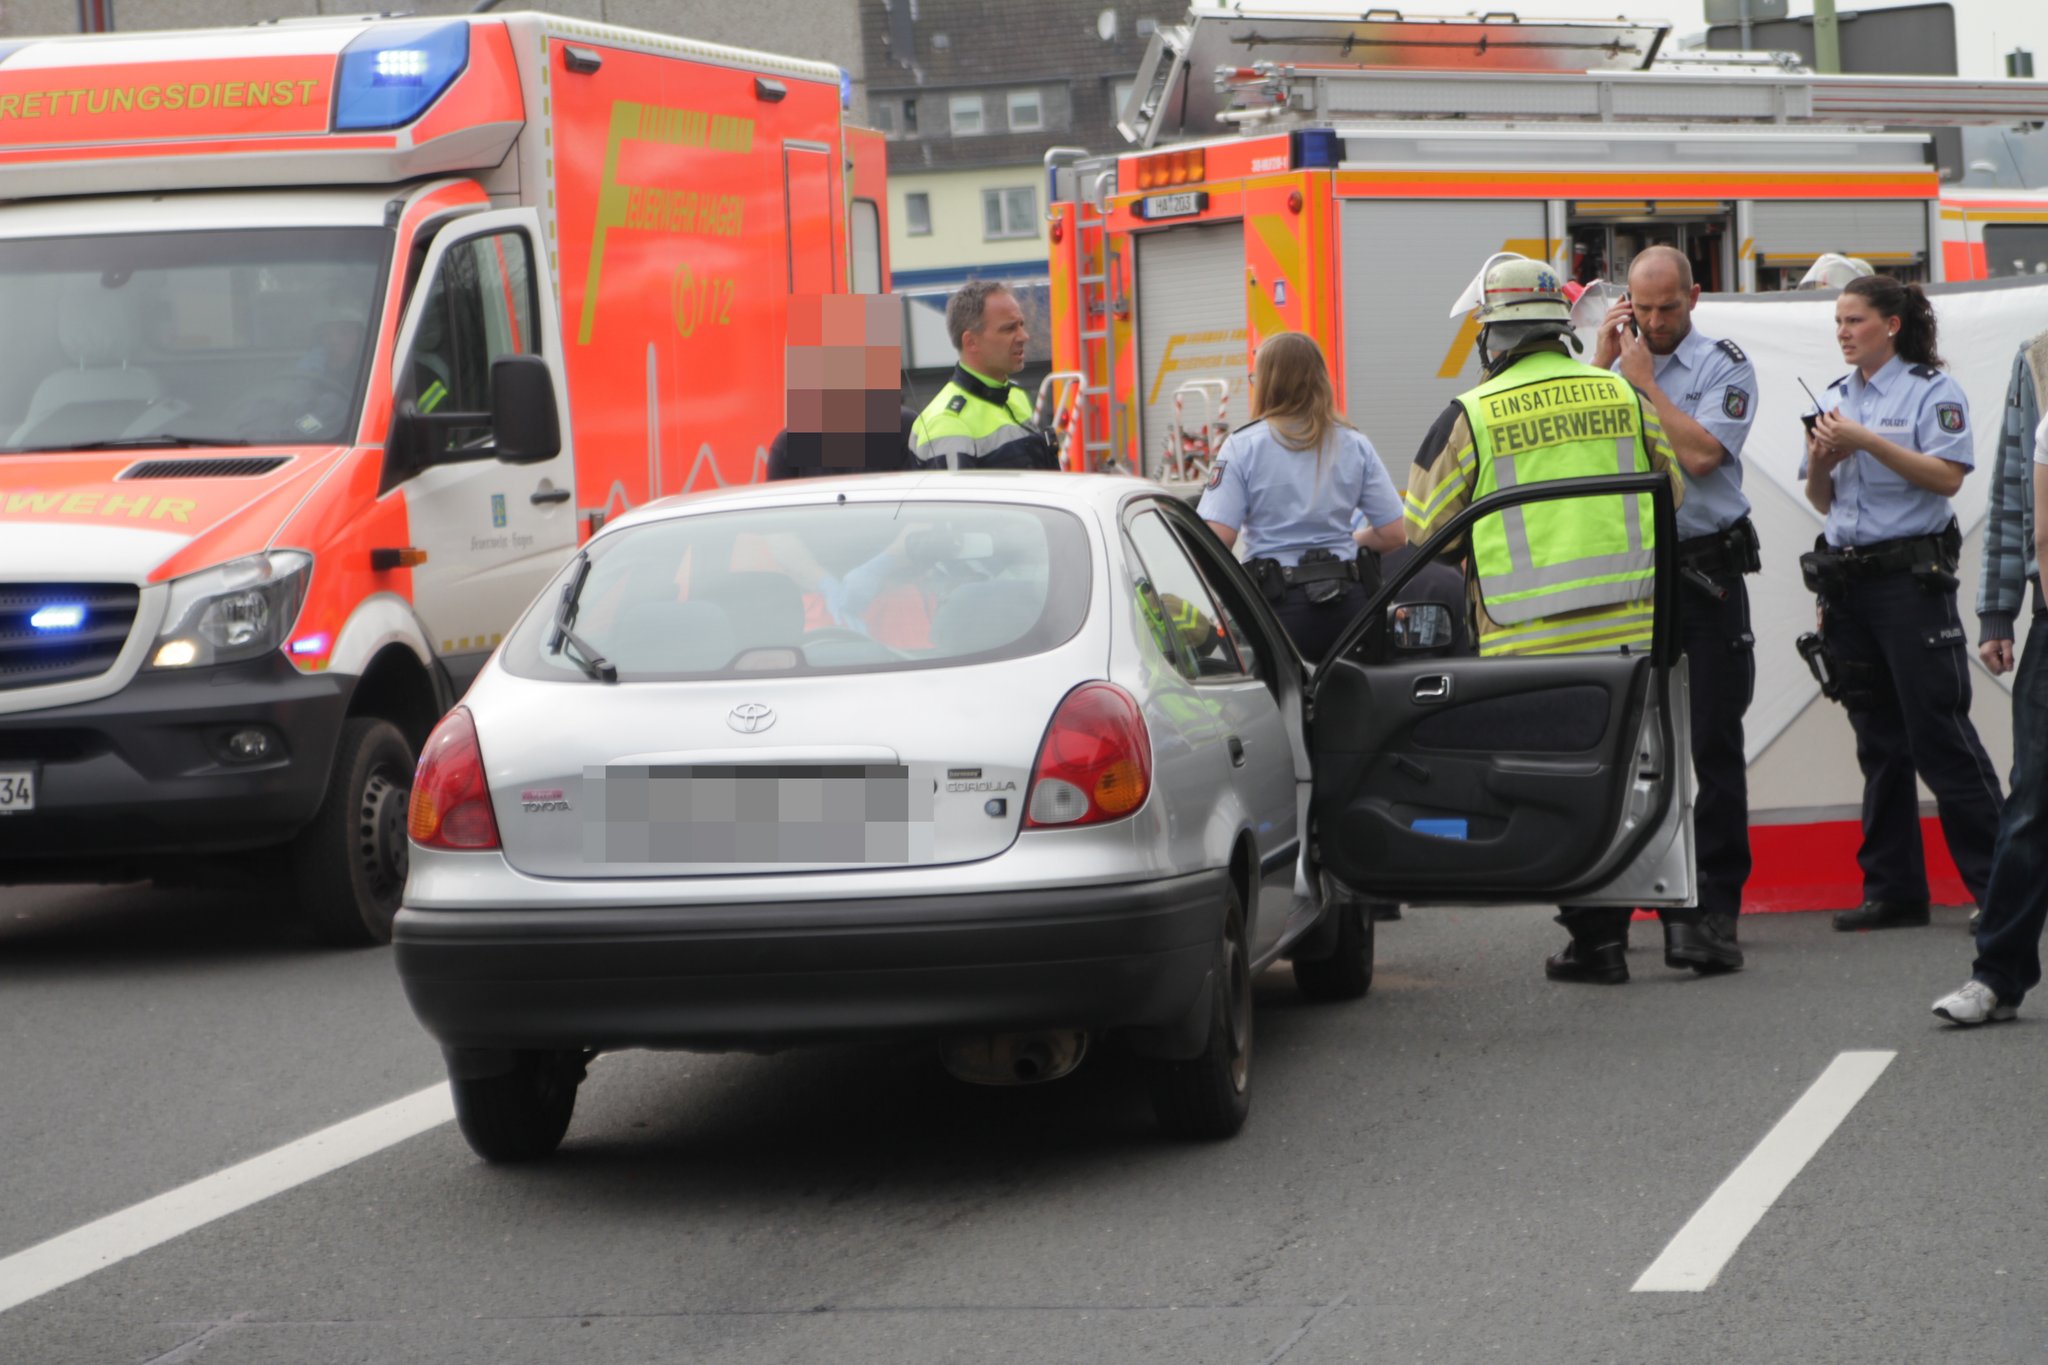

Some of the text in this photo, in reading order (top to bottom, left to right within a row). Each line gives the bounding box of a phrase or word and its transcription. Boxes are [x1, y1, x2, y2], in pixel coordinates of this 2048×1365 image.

[0, 80, 318, 120] RETTUNGSDIENST
[1156, 195, 1192, 213] HA 203
[698, 277, 735, 325] 112
[1490, 383, 1619, 418] EINSATZLEITER
[1493, 408, 1633, 452] FEUERWEHR
[0, 493, 197, 523] WEHR
[0, 778, 29, 805] 34
[946, 781, 1016, 793] COROLLA
[521, 800, 573, 813] TOYOTA
